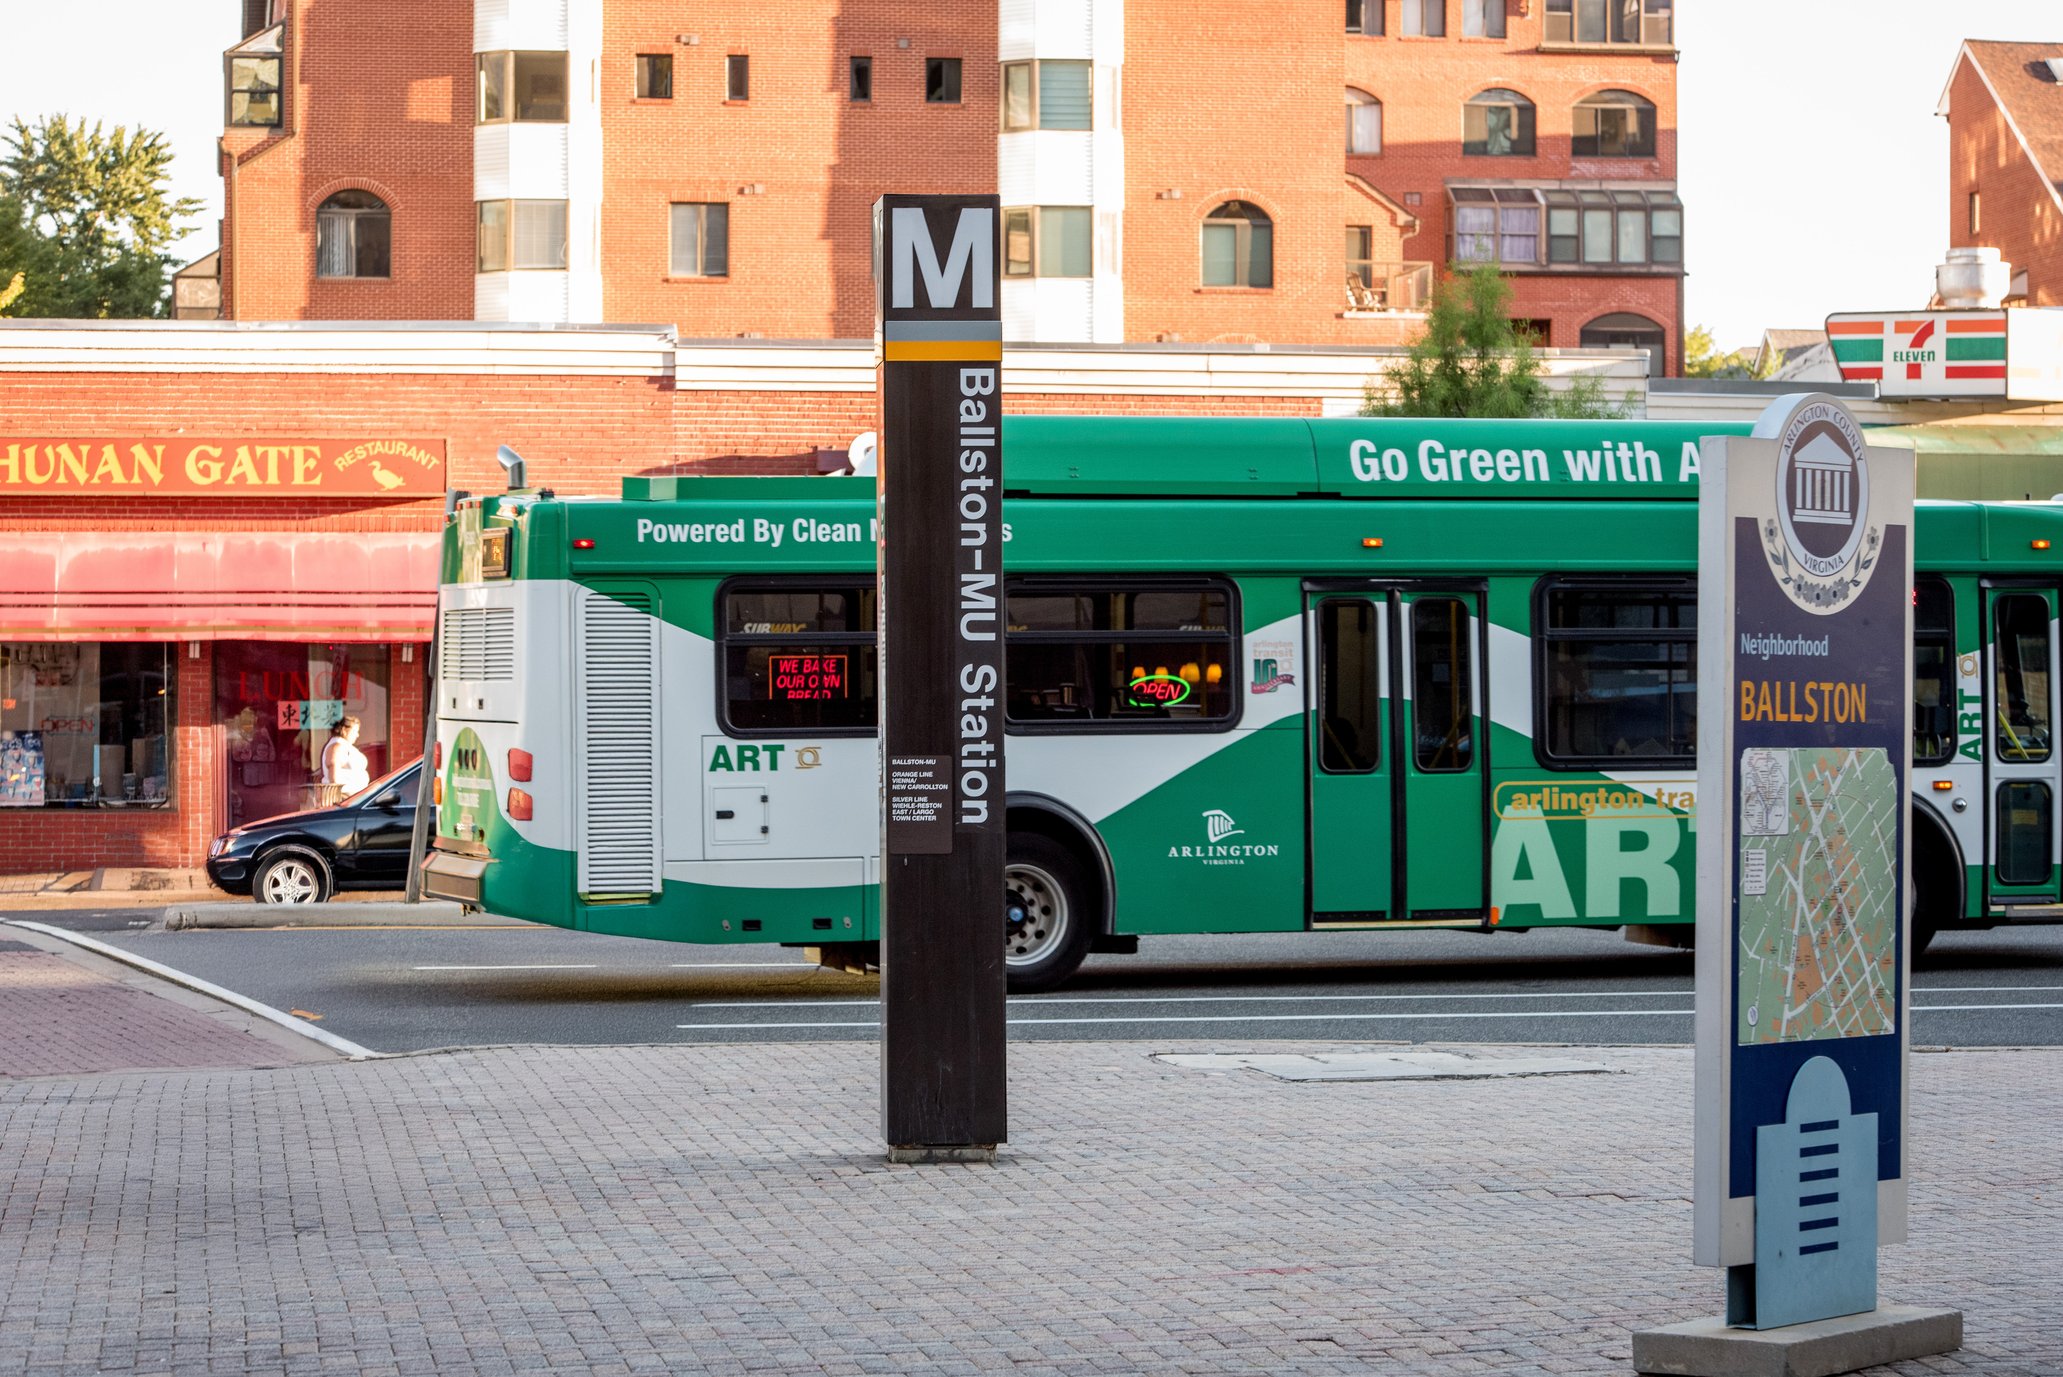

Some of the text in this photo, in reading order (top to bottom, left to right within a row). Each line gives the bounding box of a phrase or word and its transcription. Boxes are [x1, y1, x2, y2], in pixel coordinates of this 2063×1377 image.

[892, 207, 993, 308] M
[1784, 404, 1865, 461] ARLINGTON COUNTY
[0, 443, 322, 487] HUNAN GATE
[334, 440, 440, 472] RESTAURANT
[1349, 439, 1408, 482] Go
[1418, 439, 1550, 482] Green
[1563, 441, 1663, 482] with
[637, 518, 745, 543] Powered
[753, 518, 784, 547] By
[792, 517, 861, 542] Clean
[1804, 552, 1844, 573] VIRGINIA
[1741, 632, 1829, 660] Neighborhood
[779, 659, 837, 673] WE BAKE
[239, 671, 362, 700] LUNCH
[776, 675, 805, 688] OUR
[1741, 680, 1867, 723] BALLSTON
[40, 719, 94, 734] OPEN
[1958, 688, 1982, 762] ART
[708, 744, 785, 772] ART
[960, 663, 997, 824] Station
[1511, 787, 1695, 815] arlington tra
[1168, 845, 1279, 857] ARLINGTON
